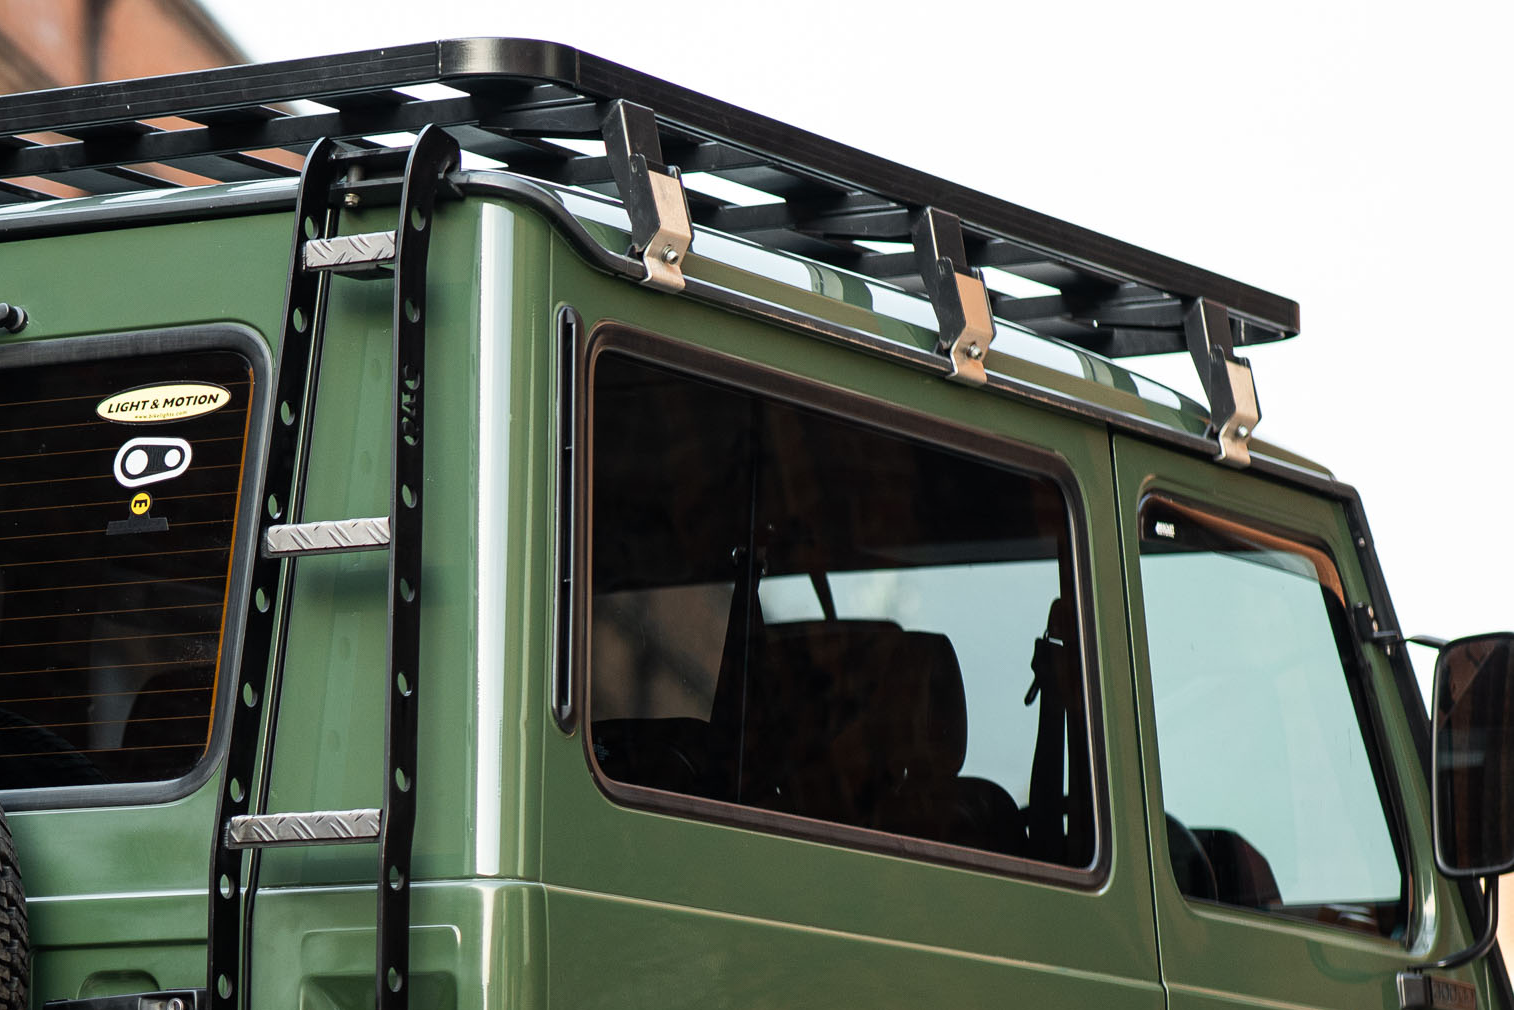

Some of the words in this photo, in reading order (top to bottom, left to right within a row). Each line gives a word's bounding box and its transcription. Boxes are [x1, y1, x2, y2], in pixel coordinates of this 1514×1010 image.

[107, 400, 149, 414] LIGHT
[150, 398, 160, 410] &
[162, 393, 219, 409] MOTION
